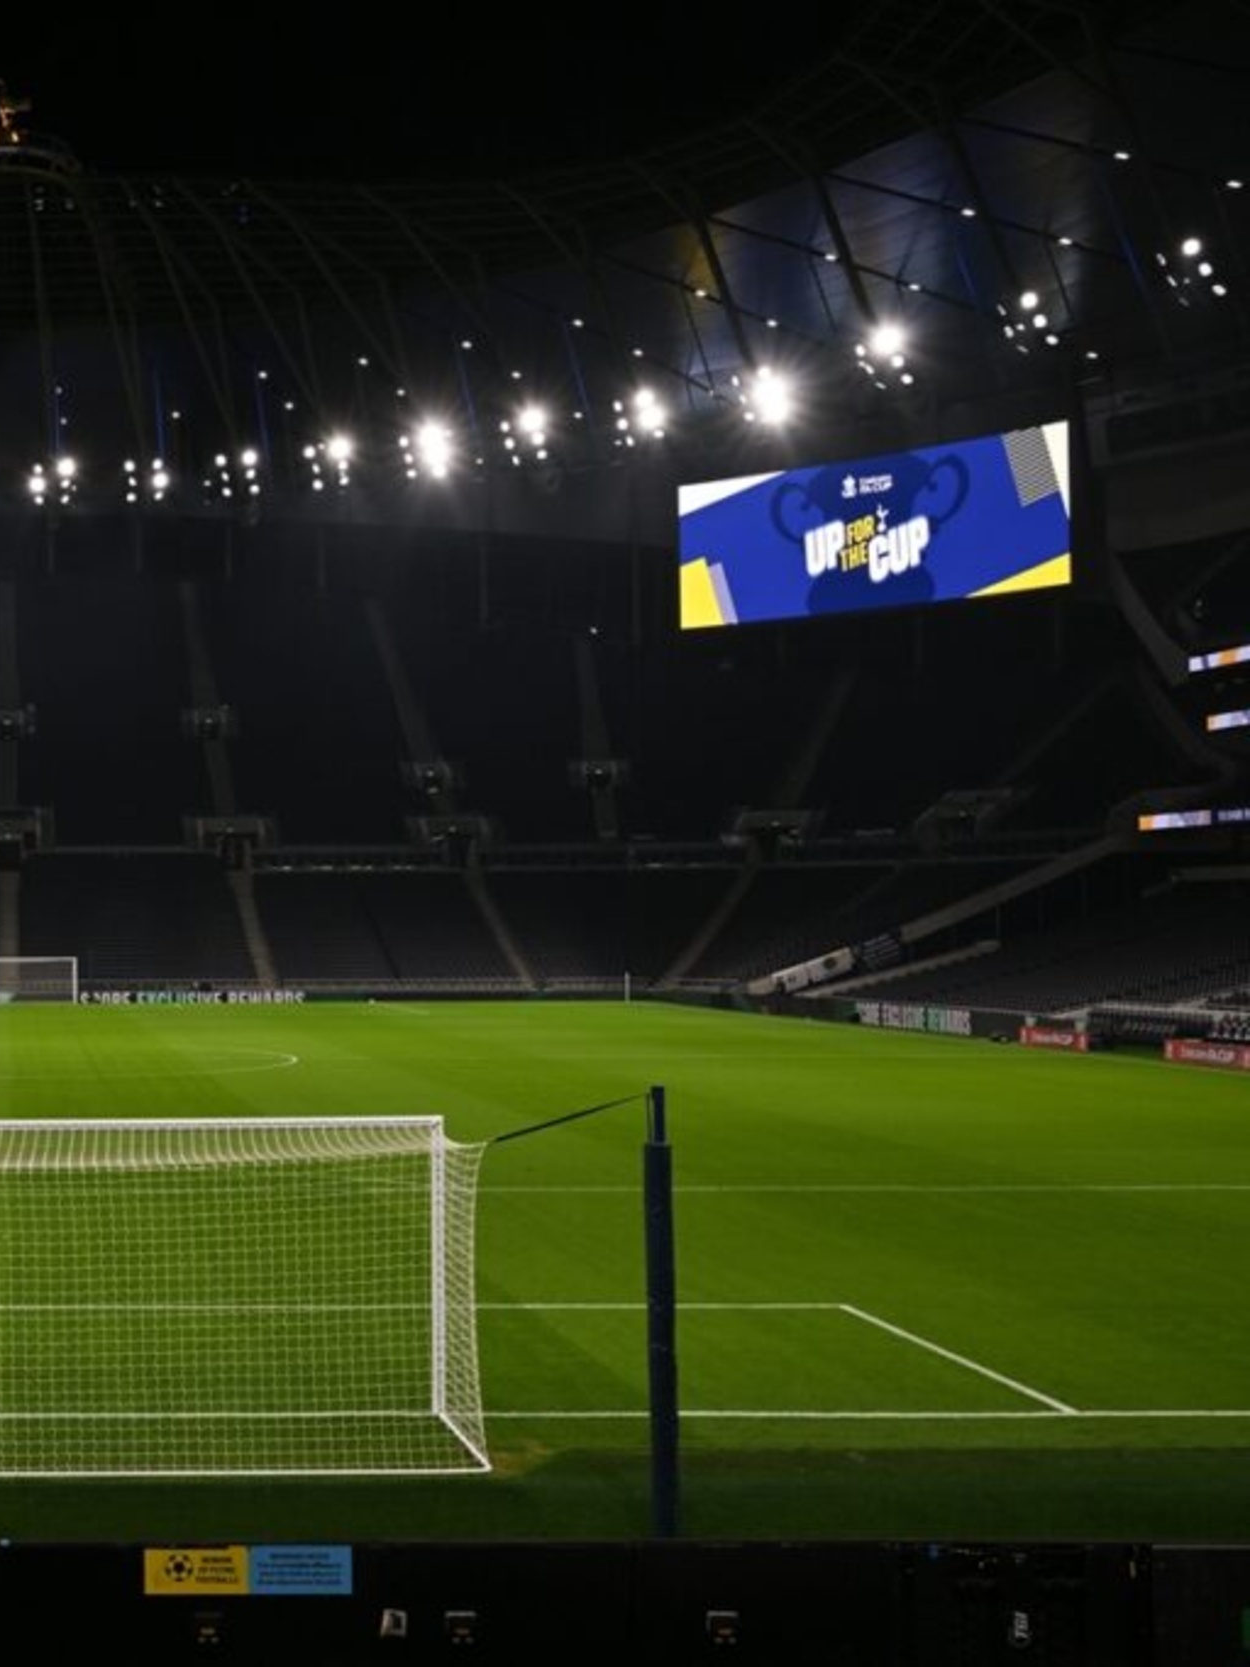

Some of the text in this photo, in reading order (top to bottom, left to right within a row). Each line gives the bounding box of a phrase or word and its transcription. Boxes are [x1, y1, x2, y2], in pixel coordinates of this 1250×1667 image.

[804, 515, 929, 583] UP FOR THE CUP
